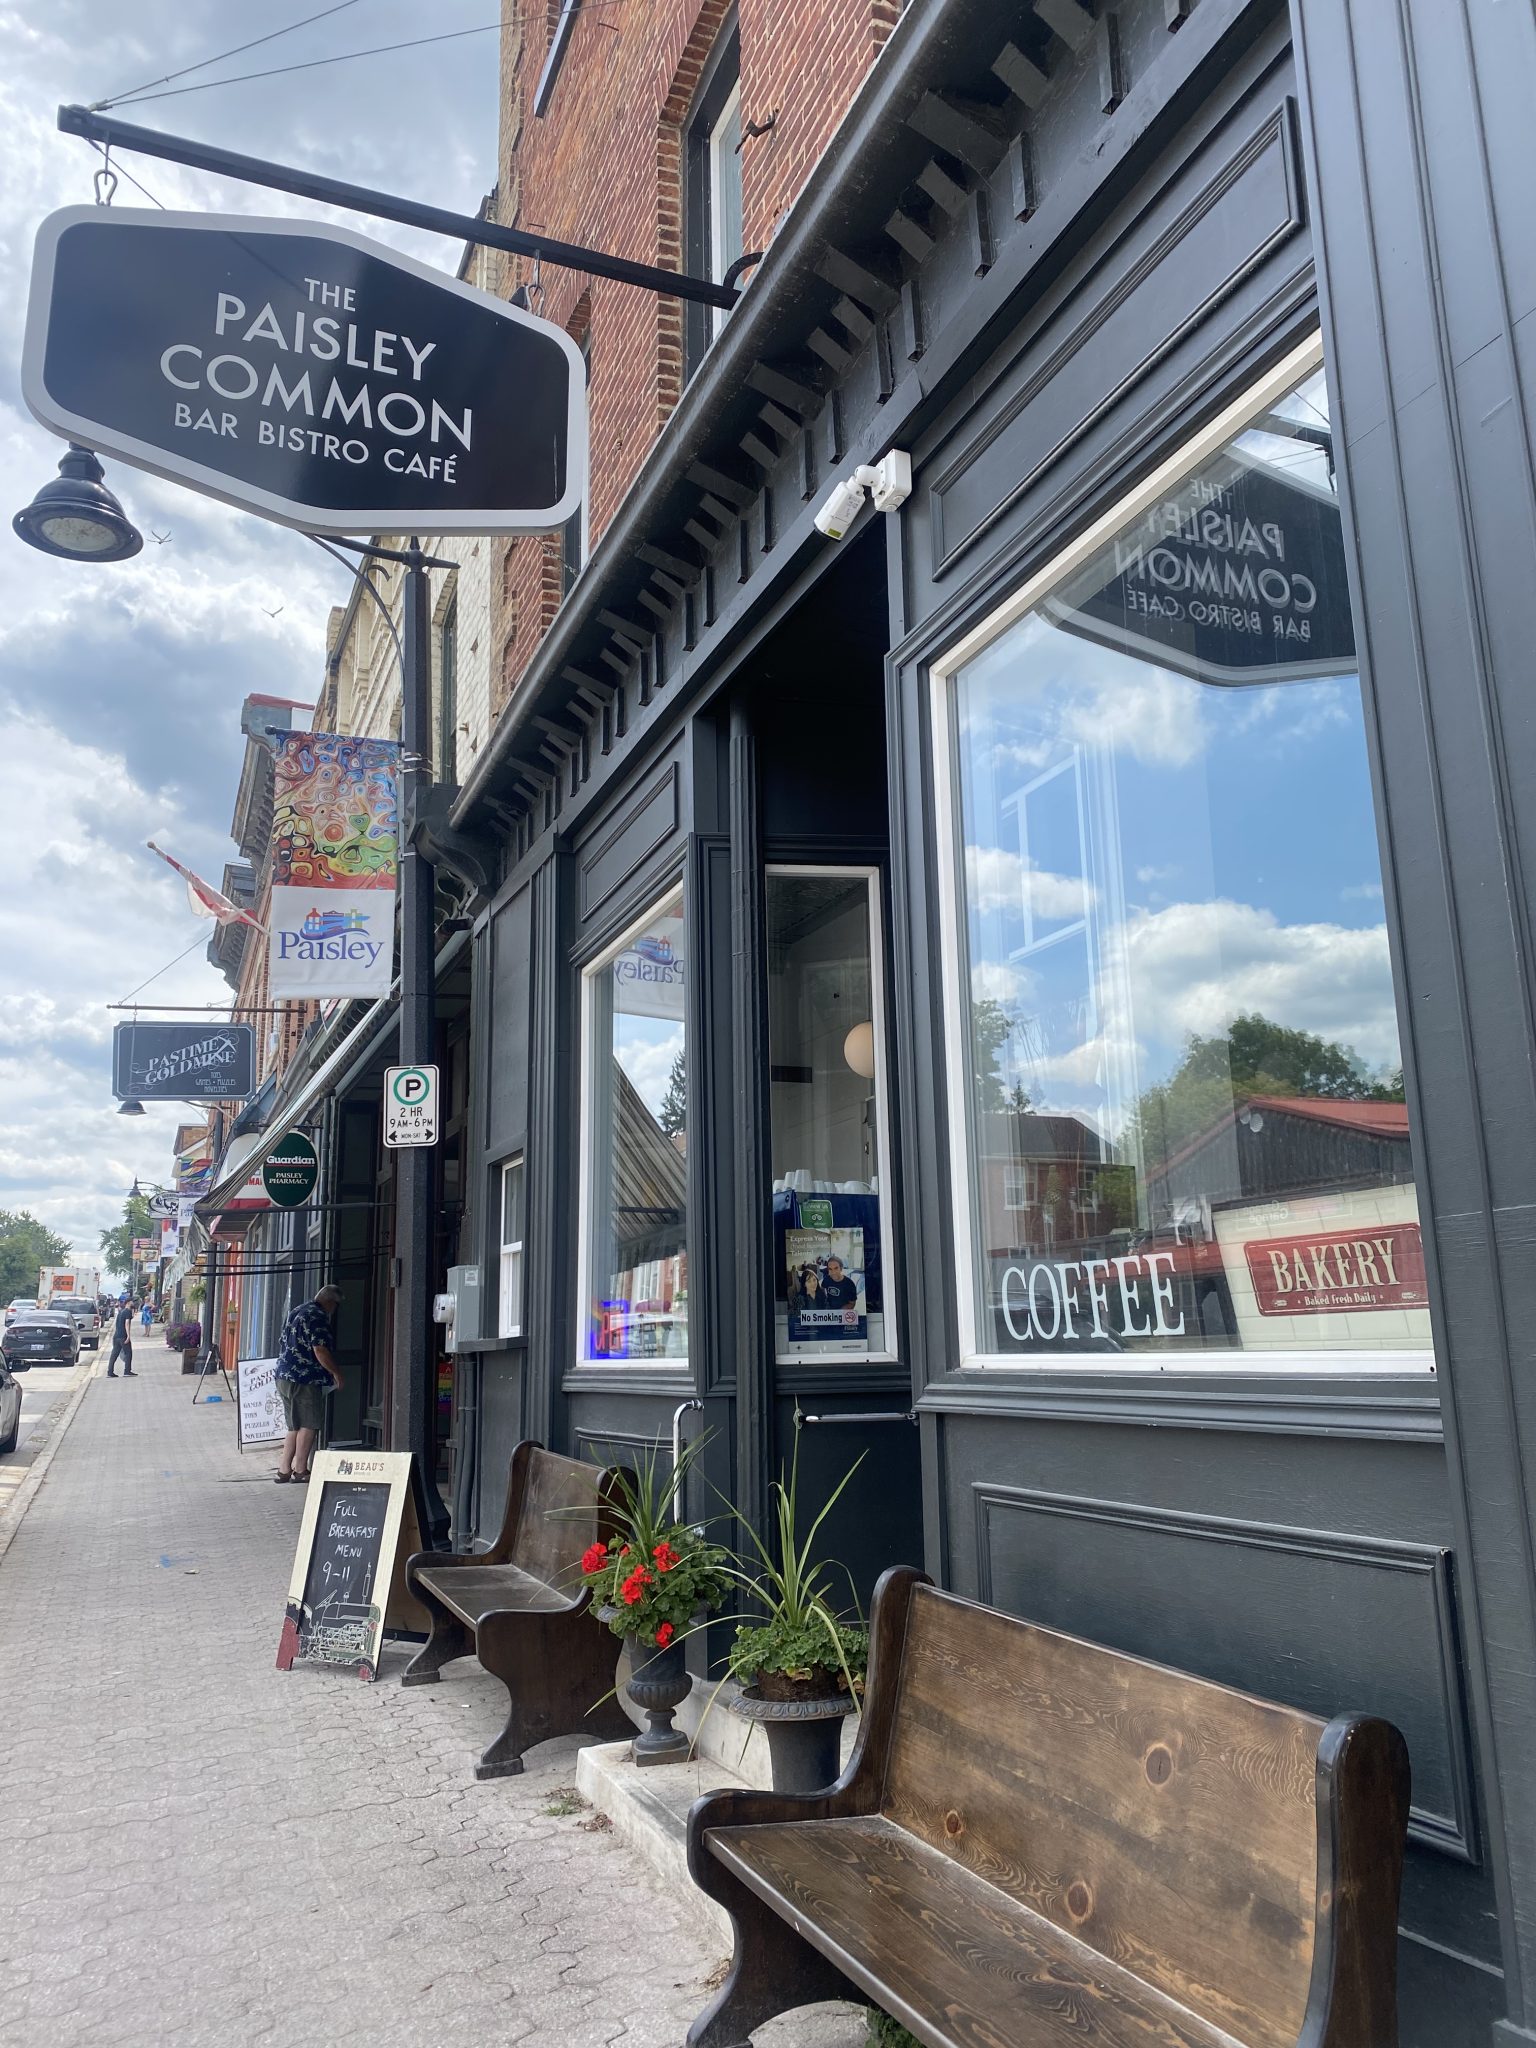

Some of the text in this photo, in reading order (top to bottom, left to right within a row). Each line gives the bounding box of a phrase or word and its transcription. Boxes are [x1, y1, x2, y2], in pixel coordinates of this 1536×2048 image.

[304, 277, 356, 313] THE
[214, 291, 437, 381] PAISLEY
[159, 343, 473, 452] COMMON
[173, 402, 458, 485] BAR BISTRO CAFÉ
[278, 930, 385, 968] Paisley
[148, 1036, 220, 1071] PASTIME
[405, 1079, 422, 1097] P
[400, 1106, 423, 1117] 2 HR
[266, 1155, 315, 1165] Guardian
[1267, 1238, 1401, 1293] BAKERY
[1002, 1252, 1186, 1341] COFFEE
[1304, 1292, 1377, 1306] Baked Fresh Daily
[801, 1312, 843, 1323] No Smoking
[328, 1522, 378, 1539] BREAKFAST
[335, 1544, 362, 1558] MENU
[322, 1561, 351, 1585] 9-11
